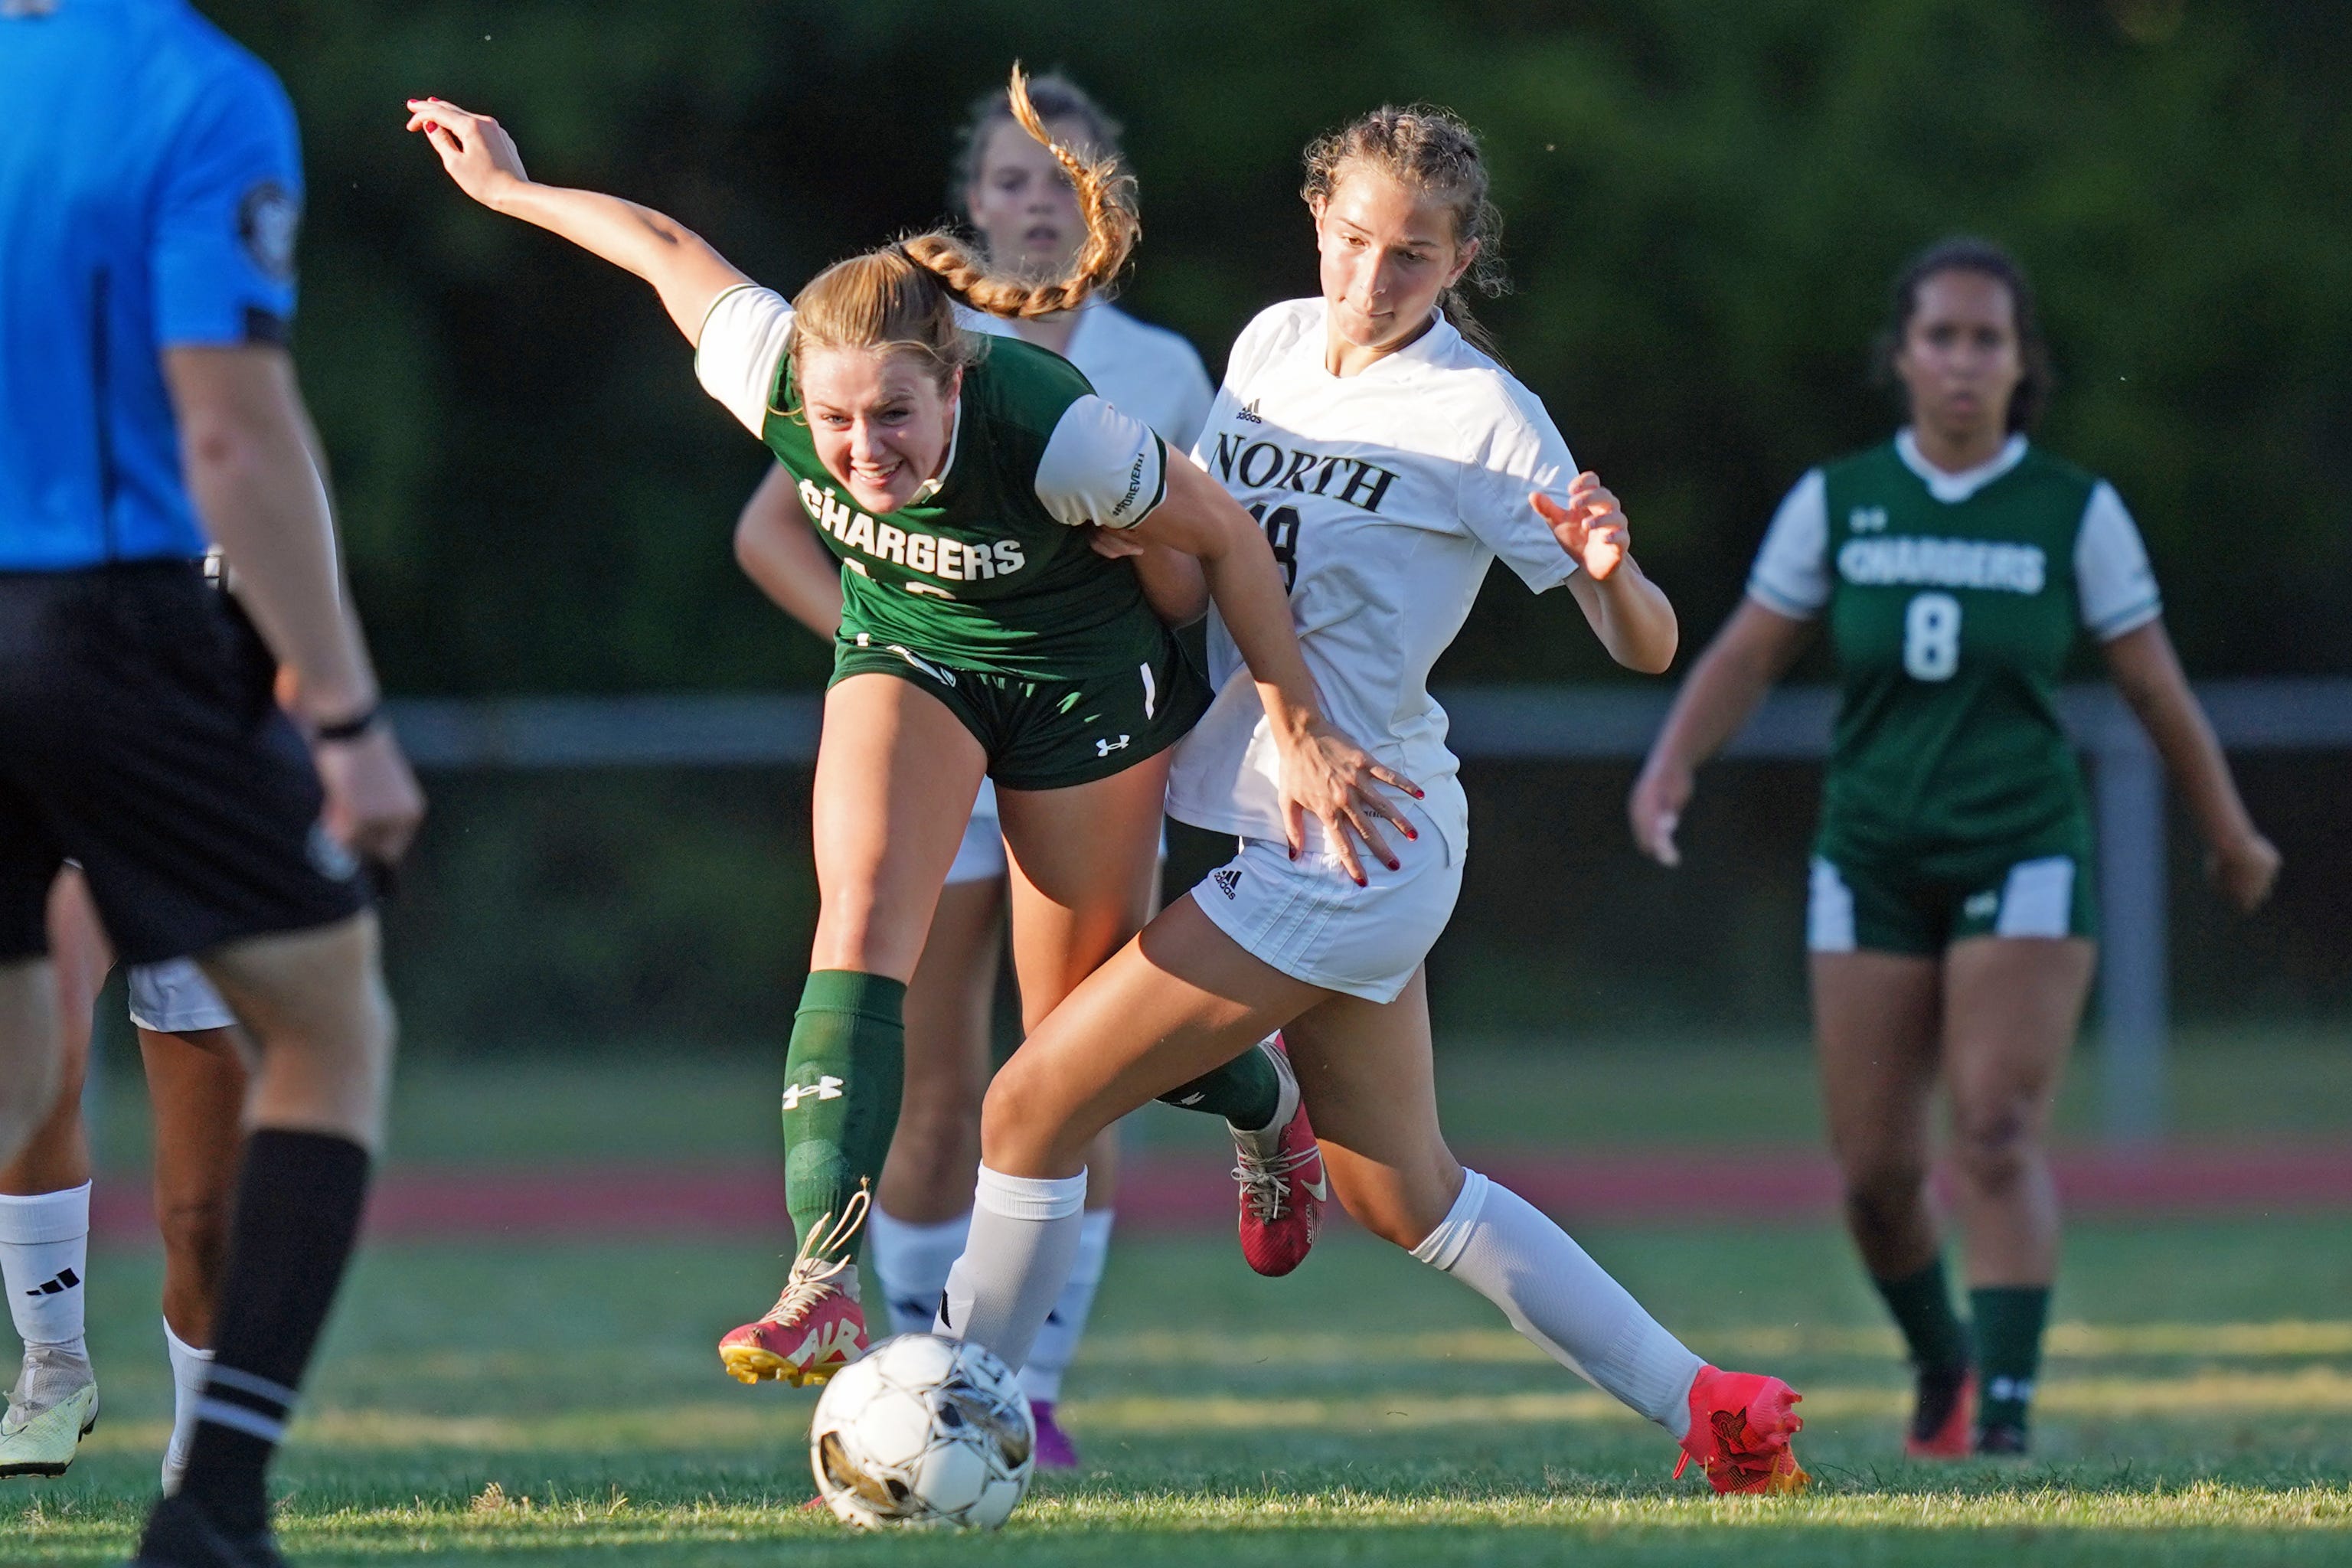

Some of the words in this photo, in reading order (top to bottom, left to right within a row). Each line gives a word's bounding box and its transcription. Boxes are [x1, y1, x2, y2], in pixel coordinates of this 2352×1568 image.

[1207, 430, 1401, 514] NORTH
[799, 478, 1025, 581] CHARGERS
[1838, 535, 2045, 595] CHARGERS
[1904, 593, 1961, 681] 8
[786, 1318, 864, 1369] AIR
